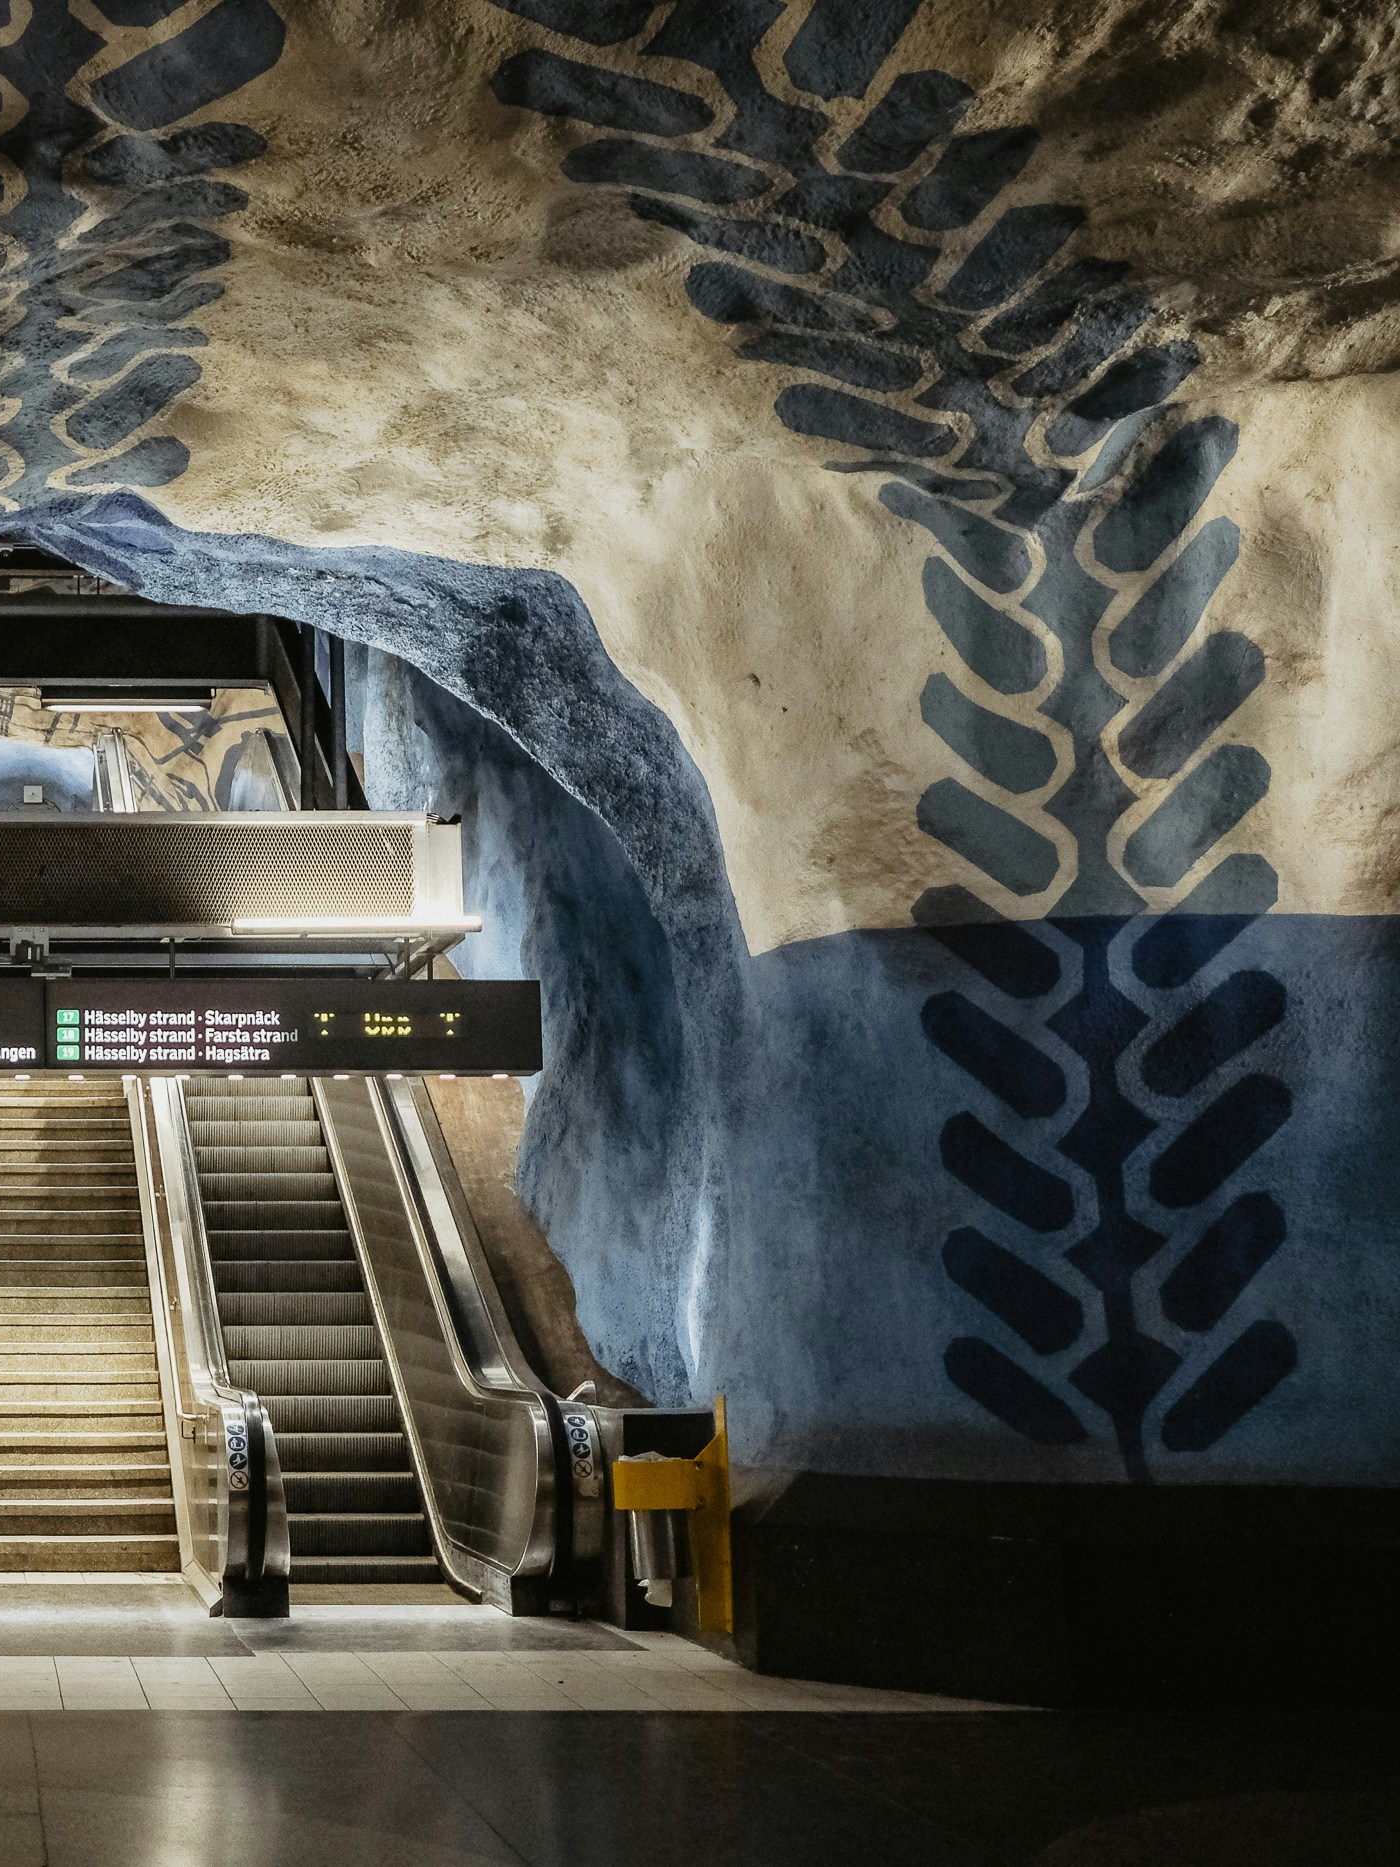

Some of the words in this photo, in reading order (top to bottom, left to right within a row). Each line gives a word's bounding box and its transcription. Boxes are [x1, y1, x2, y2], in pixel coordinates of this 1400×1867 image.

[62, 1011, 75, 1023] 17
[84, 1010, 147, 1028] Hässelby
[149, 1010, 195, 1025] strand
[205, 1010, 280, 1028] Skarpnäck
[62, 1029, 75, 1041] 18
[84, 1027, 147, 1045] Hässelby
[149, 1028, 195, 1043] strand
[205, 1027, 250, 1043] Farsta
[252, 1028, 298, 1043] strand
[62, 1047, 75, 1058] 19
[84, 1045, 147, 1063] Hässelby
[149, 1045, 196, 1061] strand
[205, 1045, 270, 1063] Hagsätra
